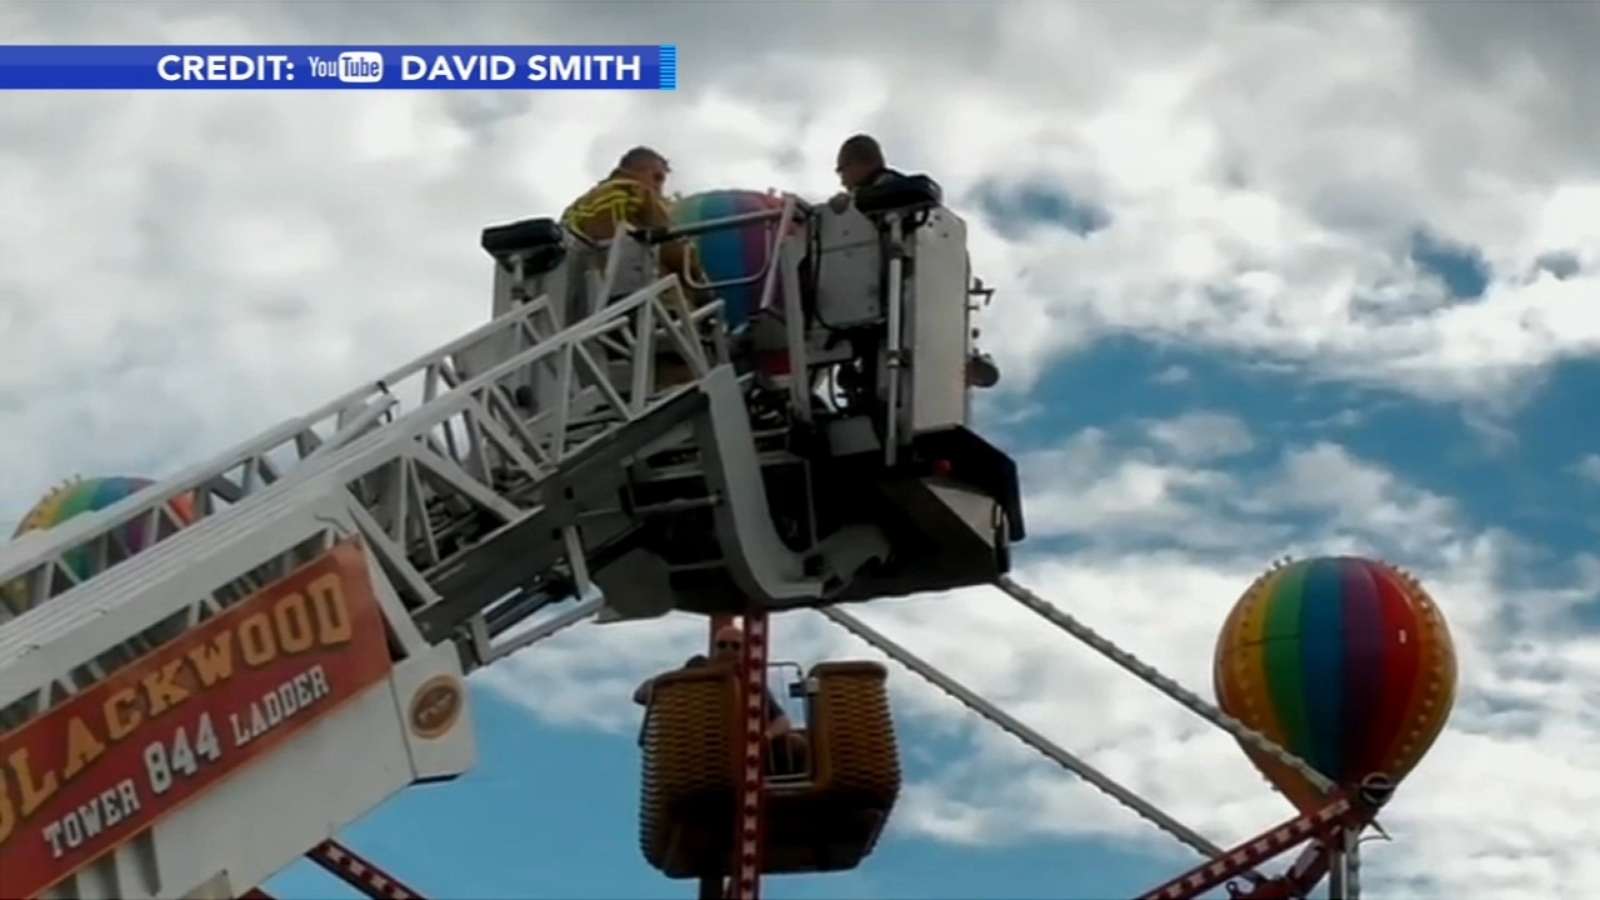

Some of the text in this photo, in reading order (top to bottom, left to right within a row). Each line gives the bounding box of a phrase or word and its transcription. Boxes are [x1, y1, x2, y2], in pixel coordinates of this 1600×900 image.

[43, 665, 329, 858] TOWER 844 LADDER
